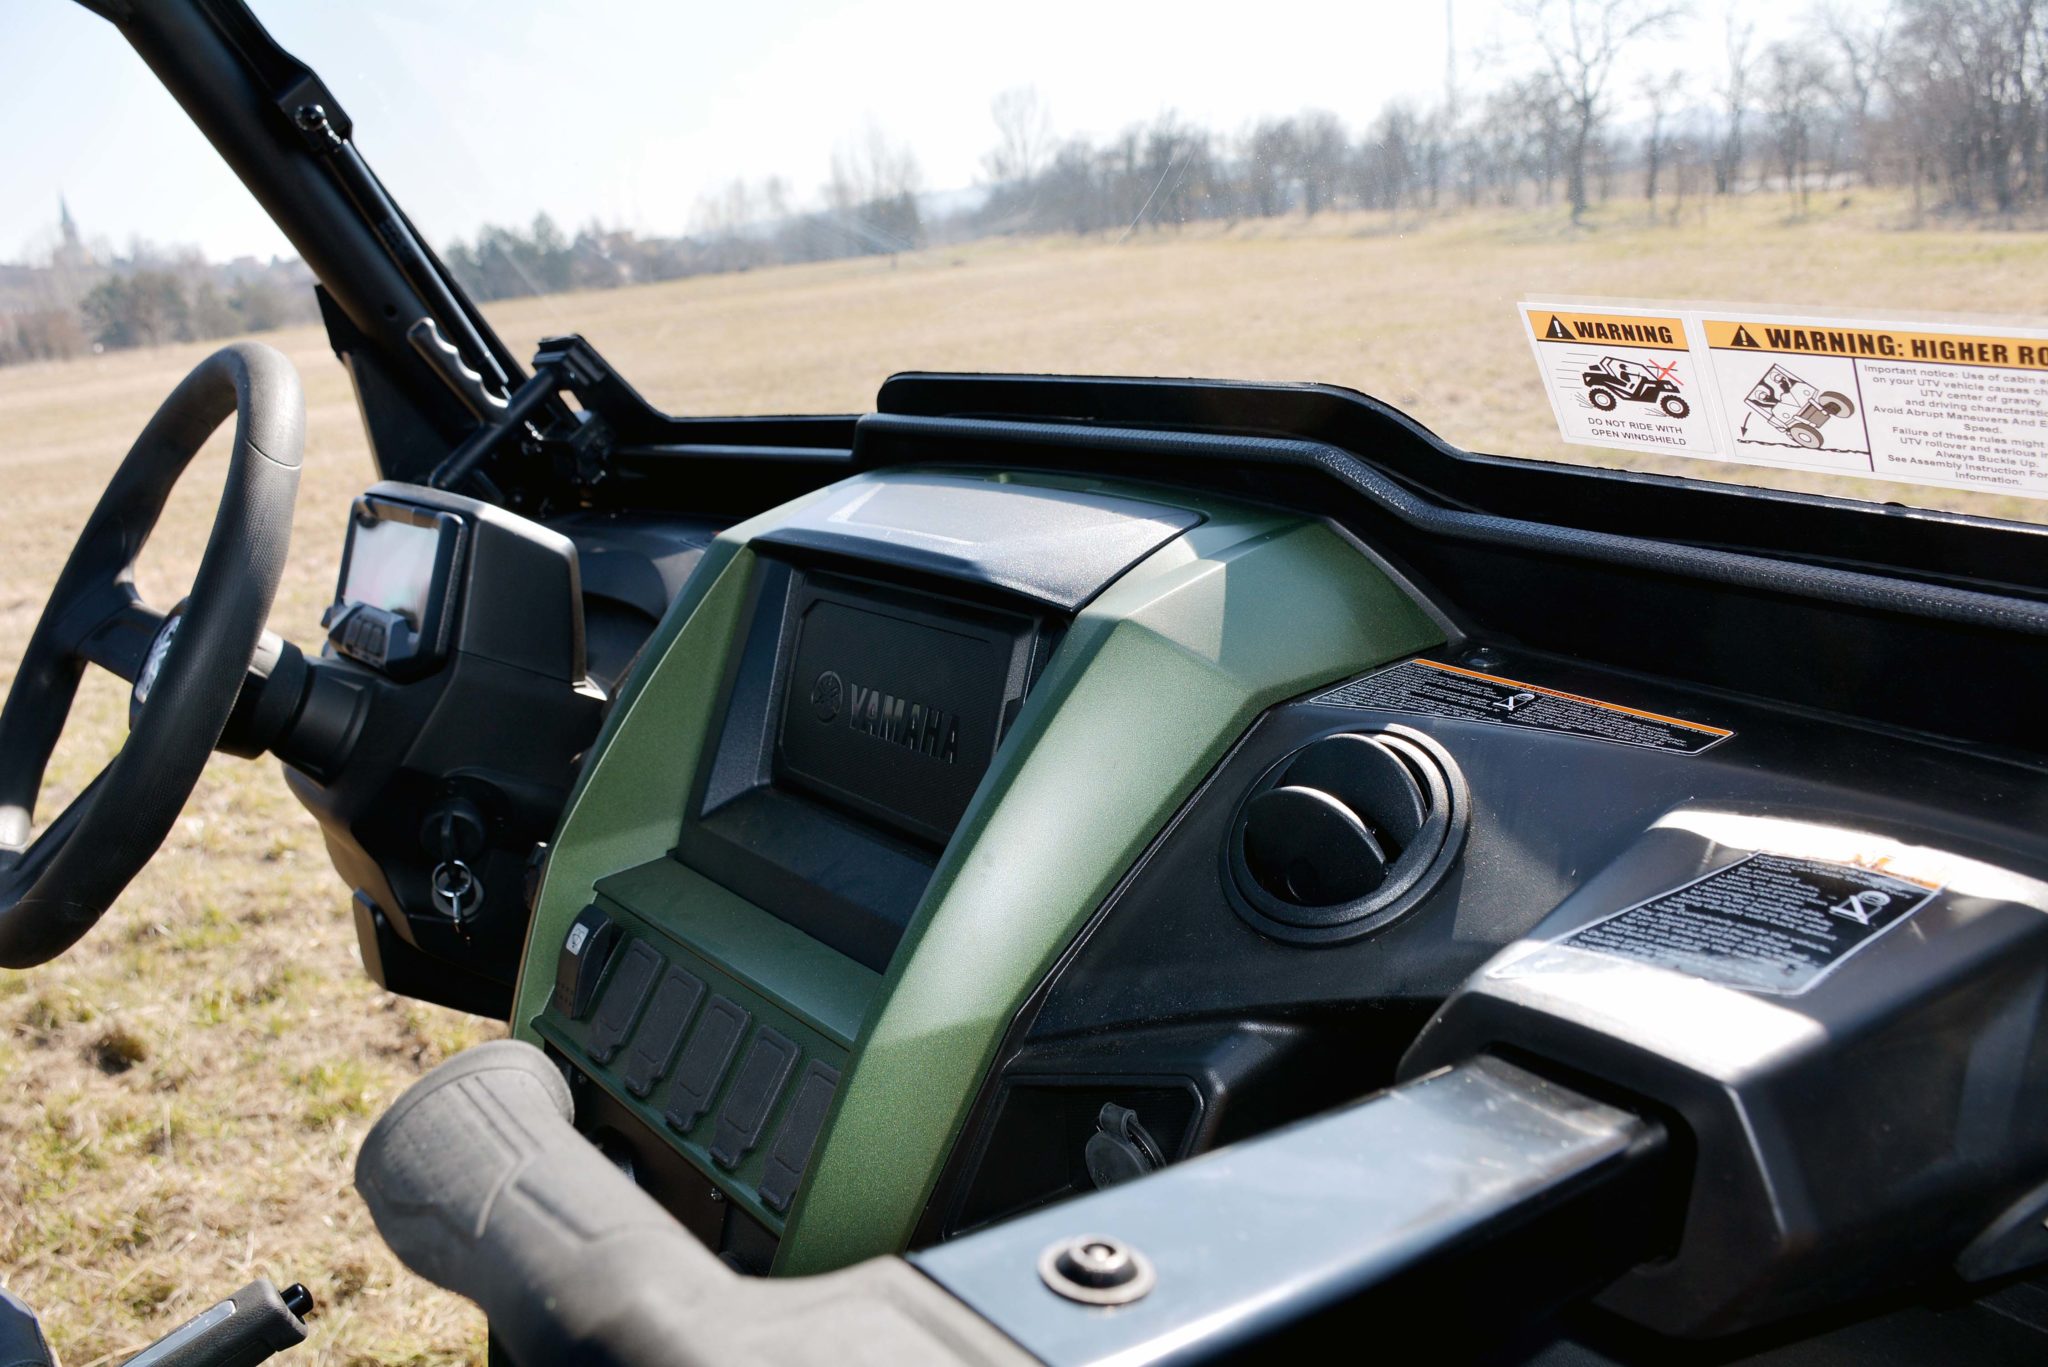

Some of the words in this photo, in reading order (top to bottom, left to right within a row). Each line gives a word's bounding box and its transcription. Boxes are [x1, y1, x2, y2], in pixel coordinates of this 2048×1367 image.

[1573, 320, 1673, 344] WARNING
[1764, 328, 1904, 357] WARNING:
[1911, 339, 2008, 364] HIGHER
[1864, 365, 1917, 377] Important
[1921, 369, 1958, 379] notice:
[1962, 372, 1984, 381] Use
[1988, 374, 1999, 382] of
[2003, 375, 2035, 384] cabin
[1889, 378, 1915, 387] your
[1917, 379, 1940, 387] UTV
[1943, 381, 1984, 391] vehicle
[1988, 386, 2029, 395] causes
[1905, 398, 1926, 407] and
[1929, 400, 1967, 412] driving
[1921, 390, 1943, 399] UTV
[1947, 392, 1983, 402] center
[1986, 394, 1998, 403] of
[2001, 397, 2042, 408] gravity
[1873, 405, 1903, 415] Avoid
[1906, 409, 1944, 420] Abrupt
[1947, 412, 2008, 425] Maneuvers
[2012, 418, 2036, 427] And
[1588, 417, 1602, 426] DO
[1605, 419, 1626, 428] NOT
[1629, 421, 1653, 430] RIDE
[1656, 423, 1683, 434] WITH
[1964, 423, 2003, 435] Speed.
[1591, 428, 1618, 438] OPEN
[1622, 431, 1686, 446] WINDSHIELD
[1892, 426, 1929, 437] Failure
[1932, 430, 1942, 438] of
[1946, 432, 1976, 442] these
[1980, 435, 2007, 445] rules
[2011, 439, 2045, 449] might
[1900, 437, 1922, 446] UTV
[1925, 440, 1967, 450] rollover
[1970, 444, 1991, 453] and
[1994, 446, 2037, 457] serious
[1888, 455, 1907, 464] See
[1910, 457, 1962, 470] Assembly
[1965, 463, 2026, 476] Instruction
[1936, 450, 1974, 462] Always
[1978, 455, 2017, 465] Buckle
[1955, 472, 2023, 486] Information.
[849, 682, 960, 766] YAMAHA
